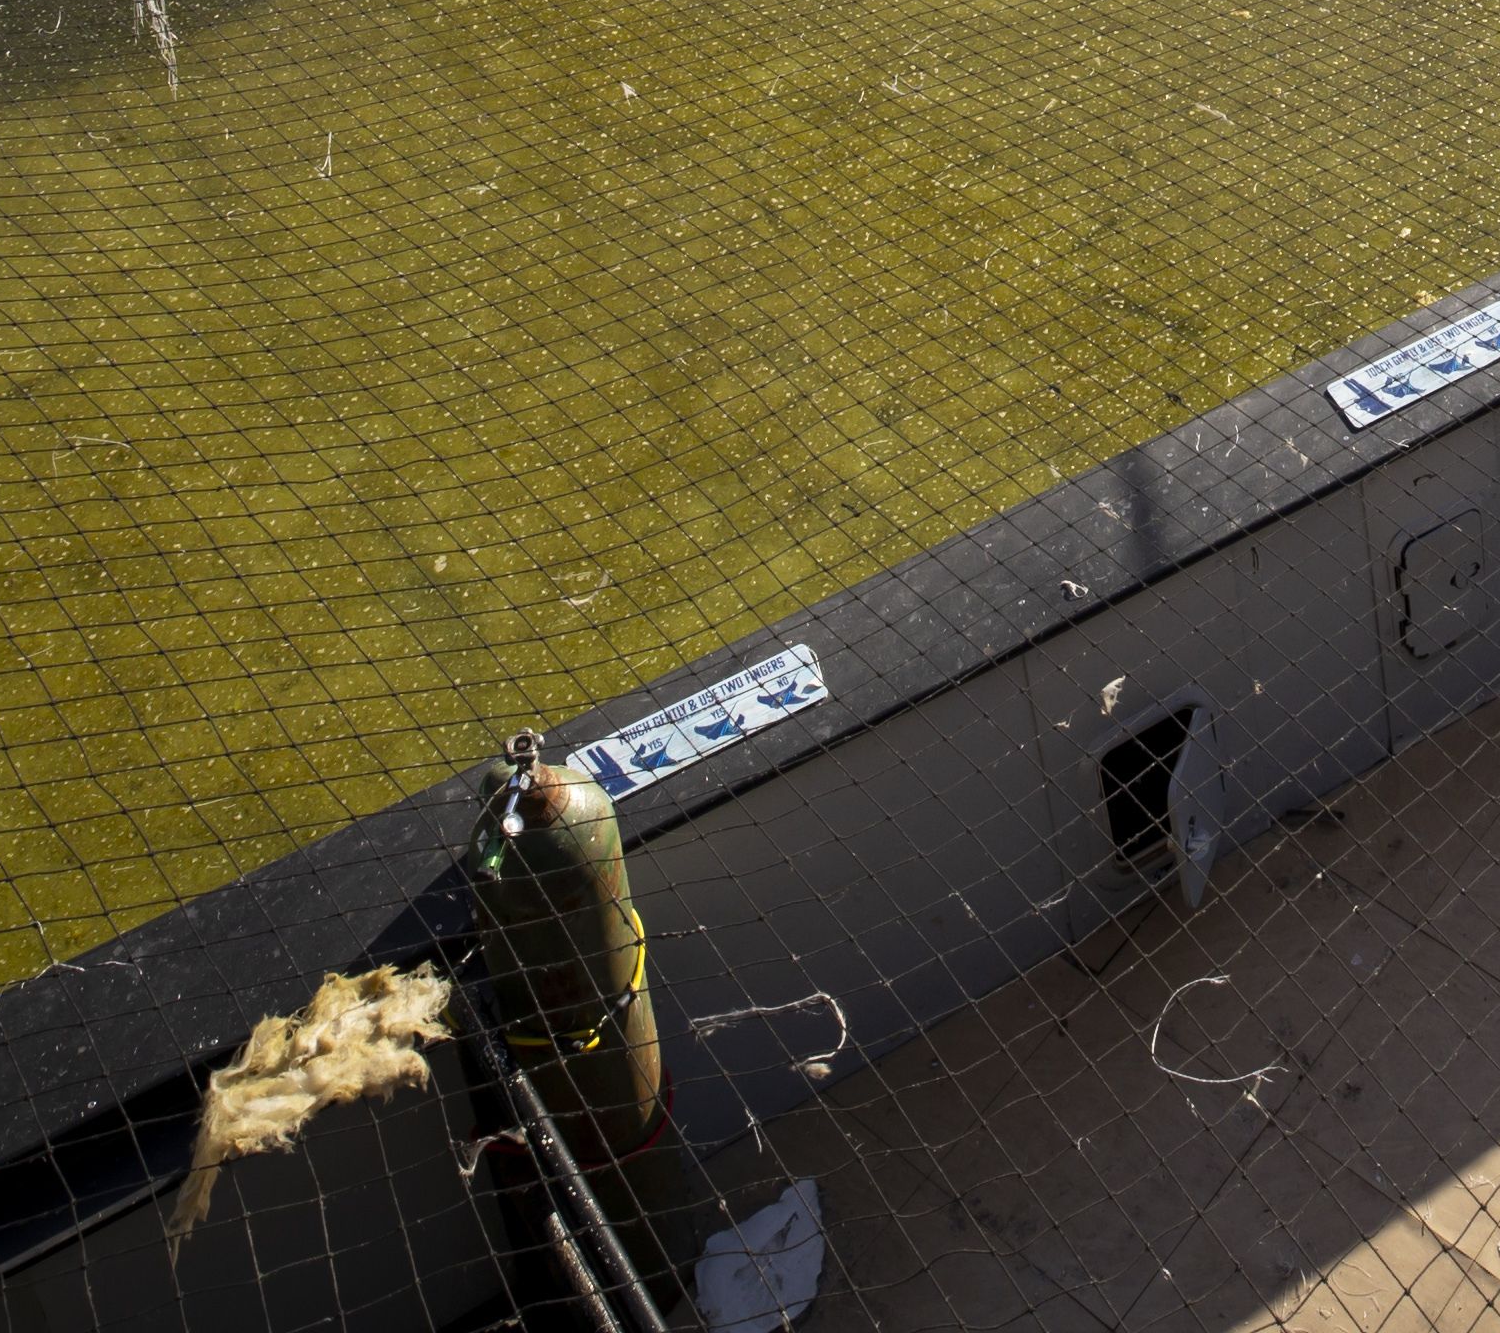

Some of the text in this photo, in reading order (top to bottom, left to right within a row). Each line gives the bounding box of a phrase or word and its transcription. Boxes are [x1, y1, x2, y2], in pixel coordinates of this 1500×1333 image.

[776, 676, 789, 688] NO
[619, 722, 651, 745] TOUCH
[653, 705, 687, 727] GENTLY
[688, 700, 698, 711] &
[720, 678, 744, 696] TWO
[745, 657, 786, 683] FINGERS
[710, 707, 726, 720] YES
[647, 738, 663, 751] YES
